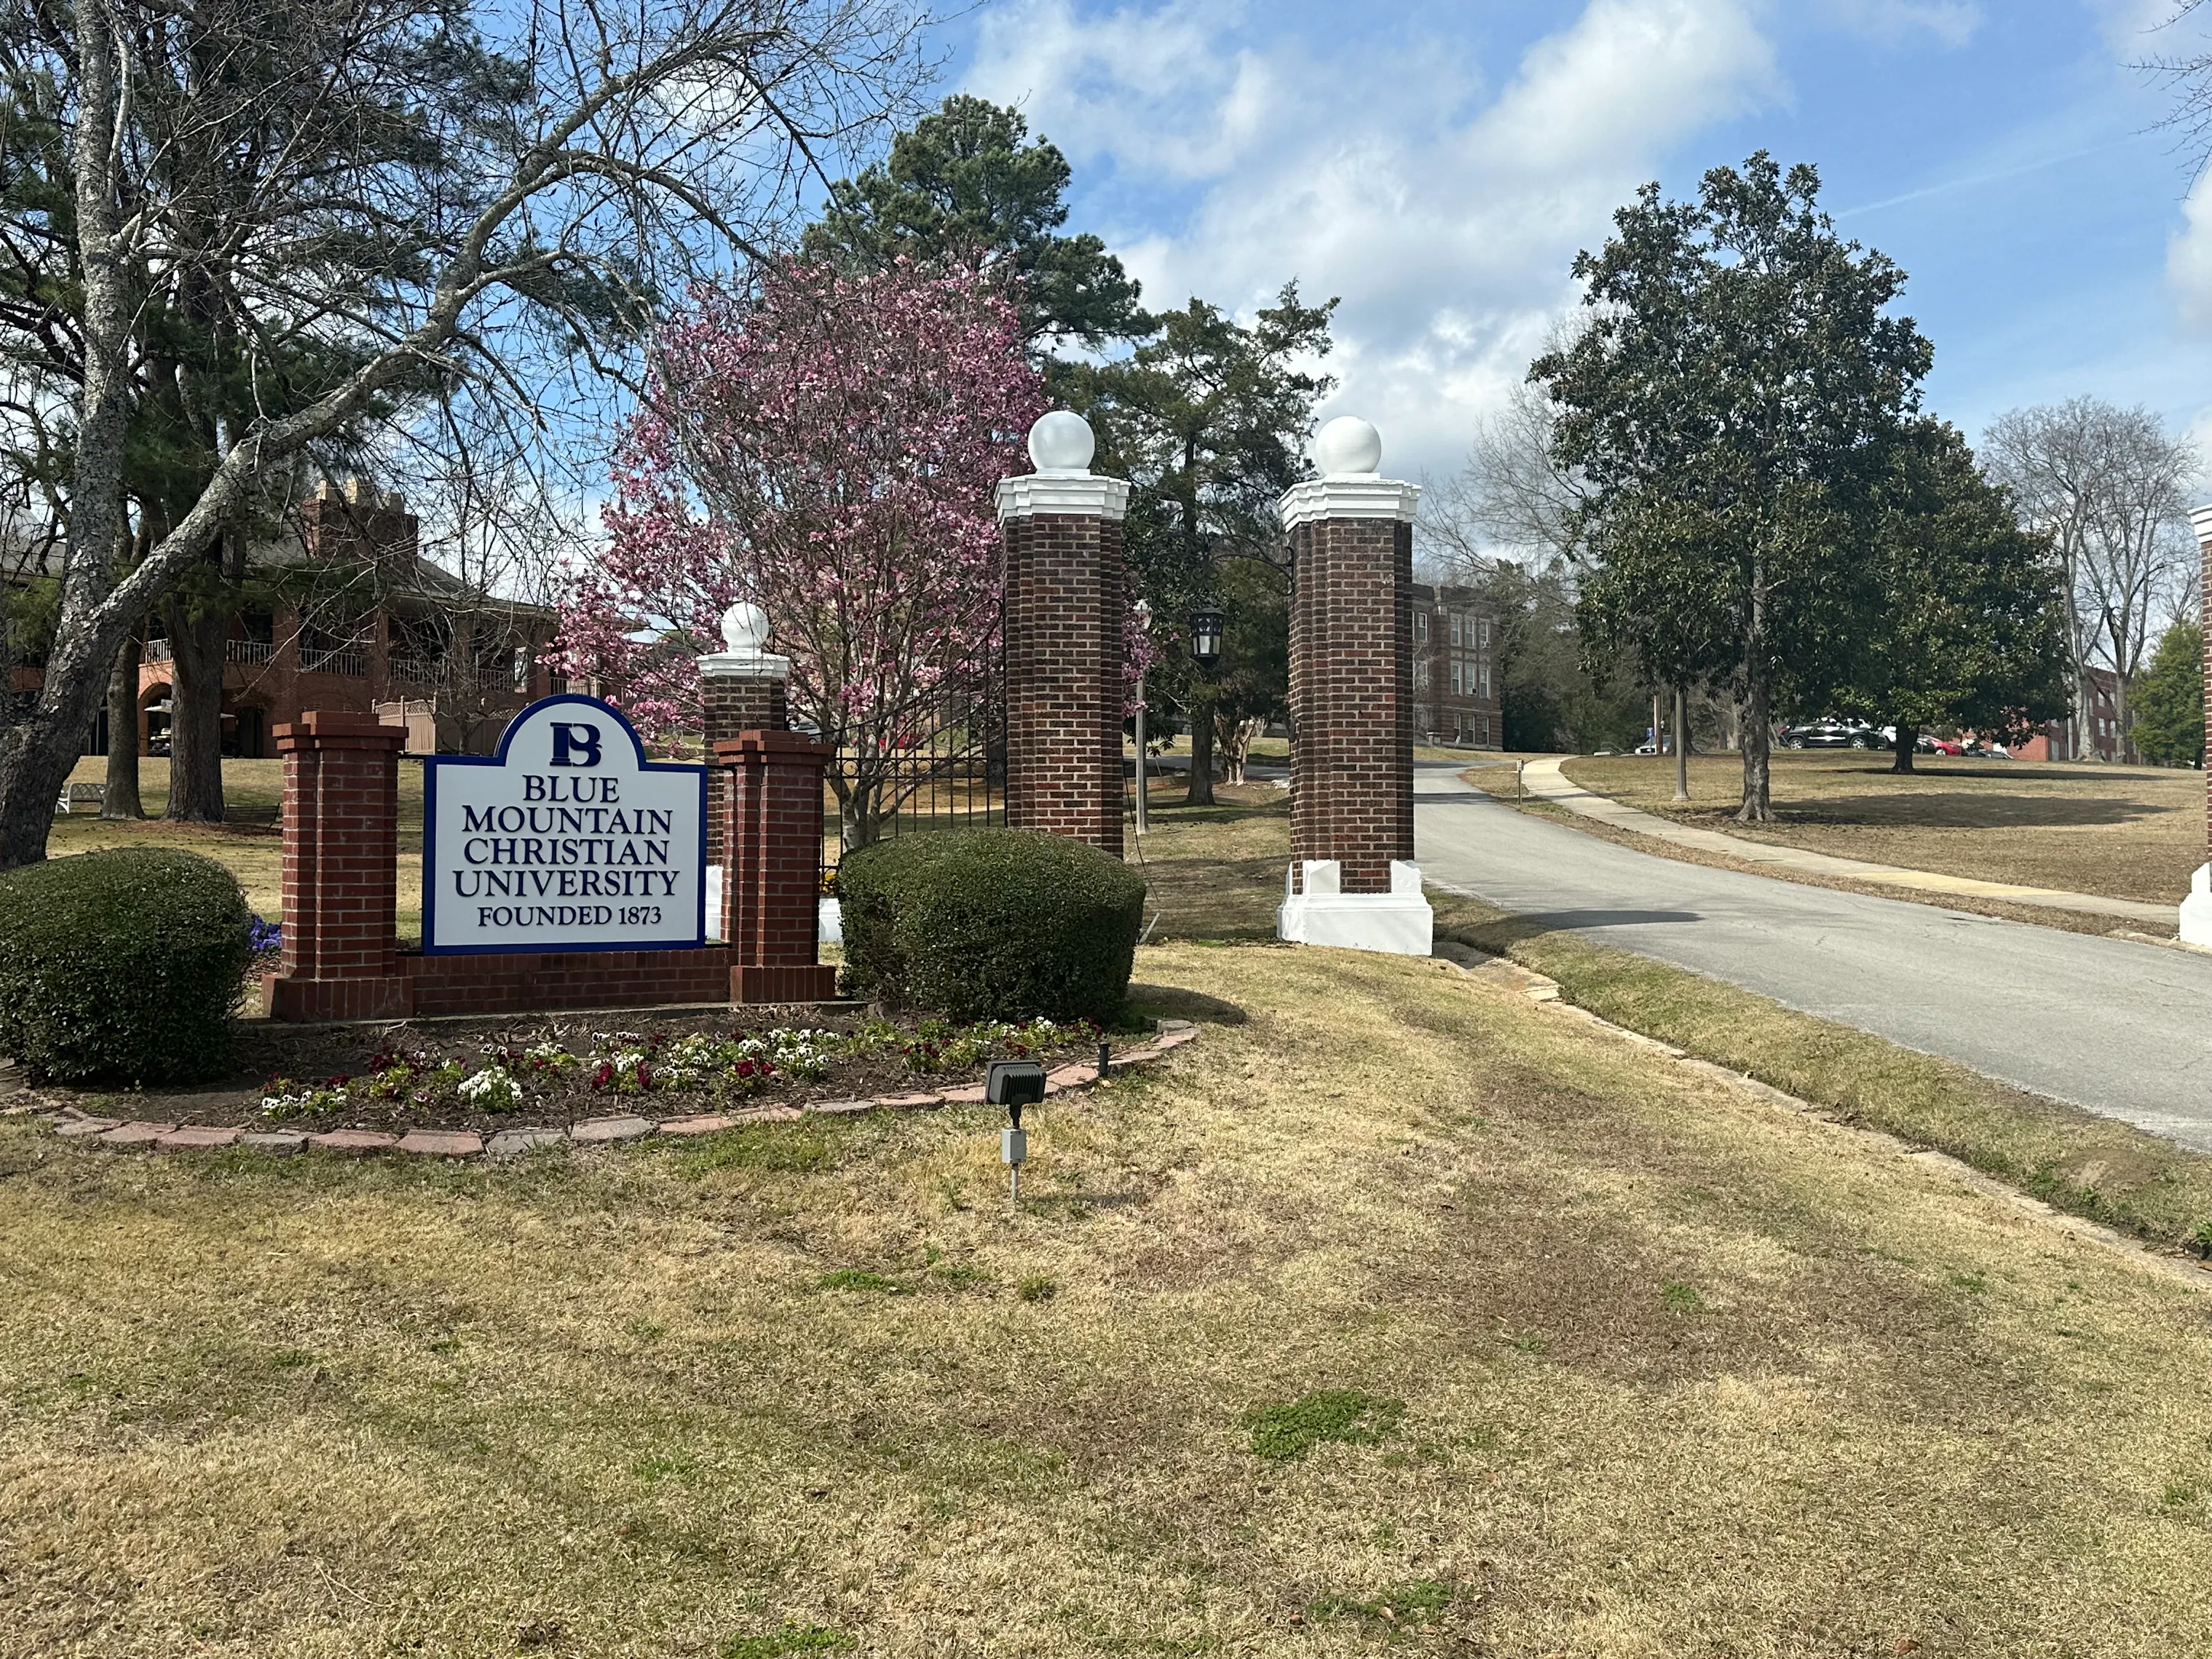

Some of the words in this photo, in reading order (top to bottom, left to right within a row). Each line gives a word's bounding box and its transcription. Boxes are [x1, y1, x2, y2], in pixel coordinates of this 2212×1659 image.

[522, 775, 620, 802] BLUE
[462, 805, 673, 834] MOUNTAIN
[465, 838, 669, 865] CHRISTIAN
[452, 870, 680, 898] UNIVERSITY
[478, 906, 612, 927] FOUNDED
[619, 906, 661, 925] 1873
